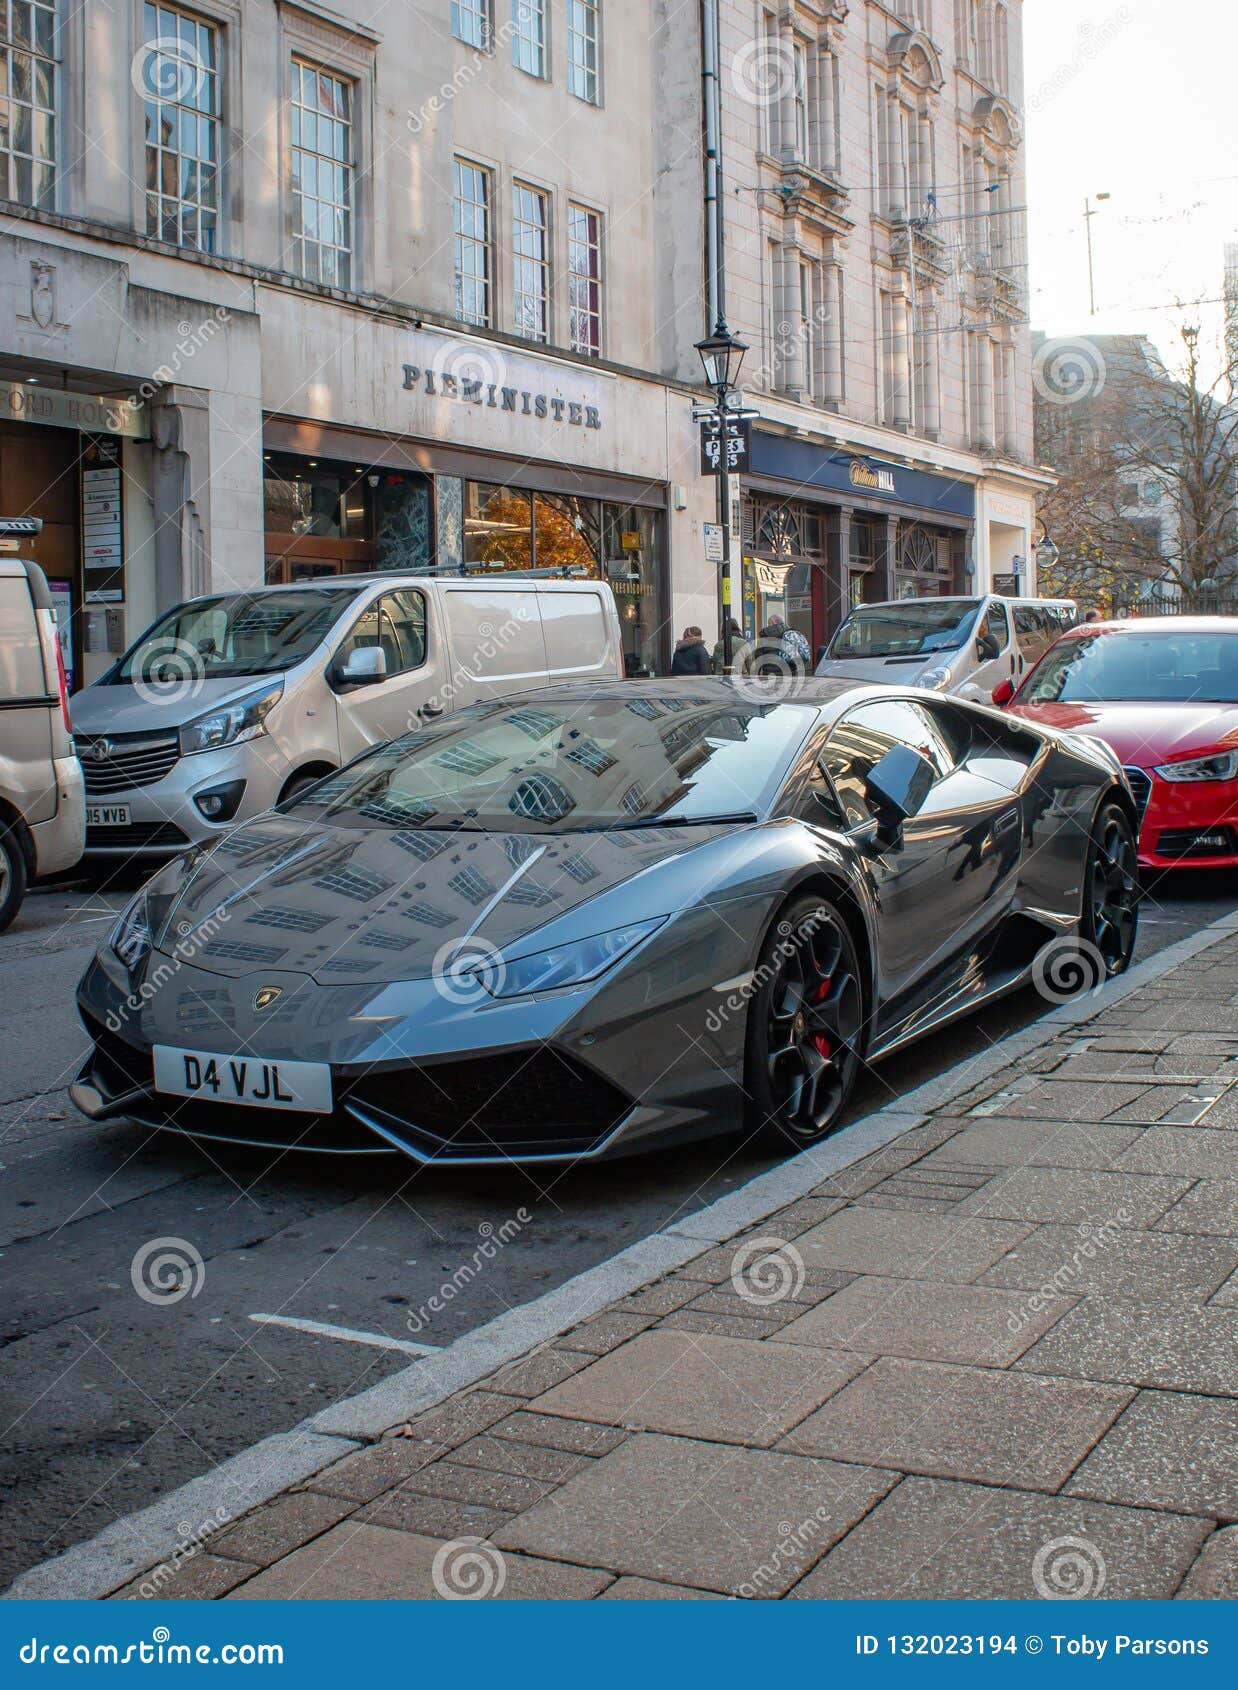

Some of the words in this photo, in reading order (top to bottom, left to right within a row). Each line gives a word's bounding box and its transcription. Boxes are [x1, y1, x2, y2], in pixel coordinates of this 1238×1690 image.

[402, 364, 601, 429] PIEMINISTER
[711, 440, 740, 454] PES
[878, 470, 895, 492] HILL
[184, 1055, 221, 1094] D4
